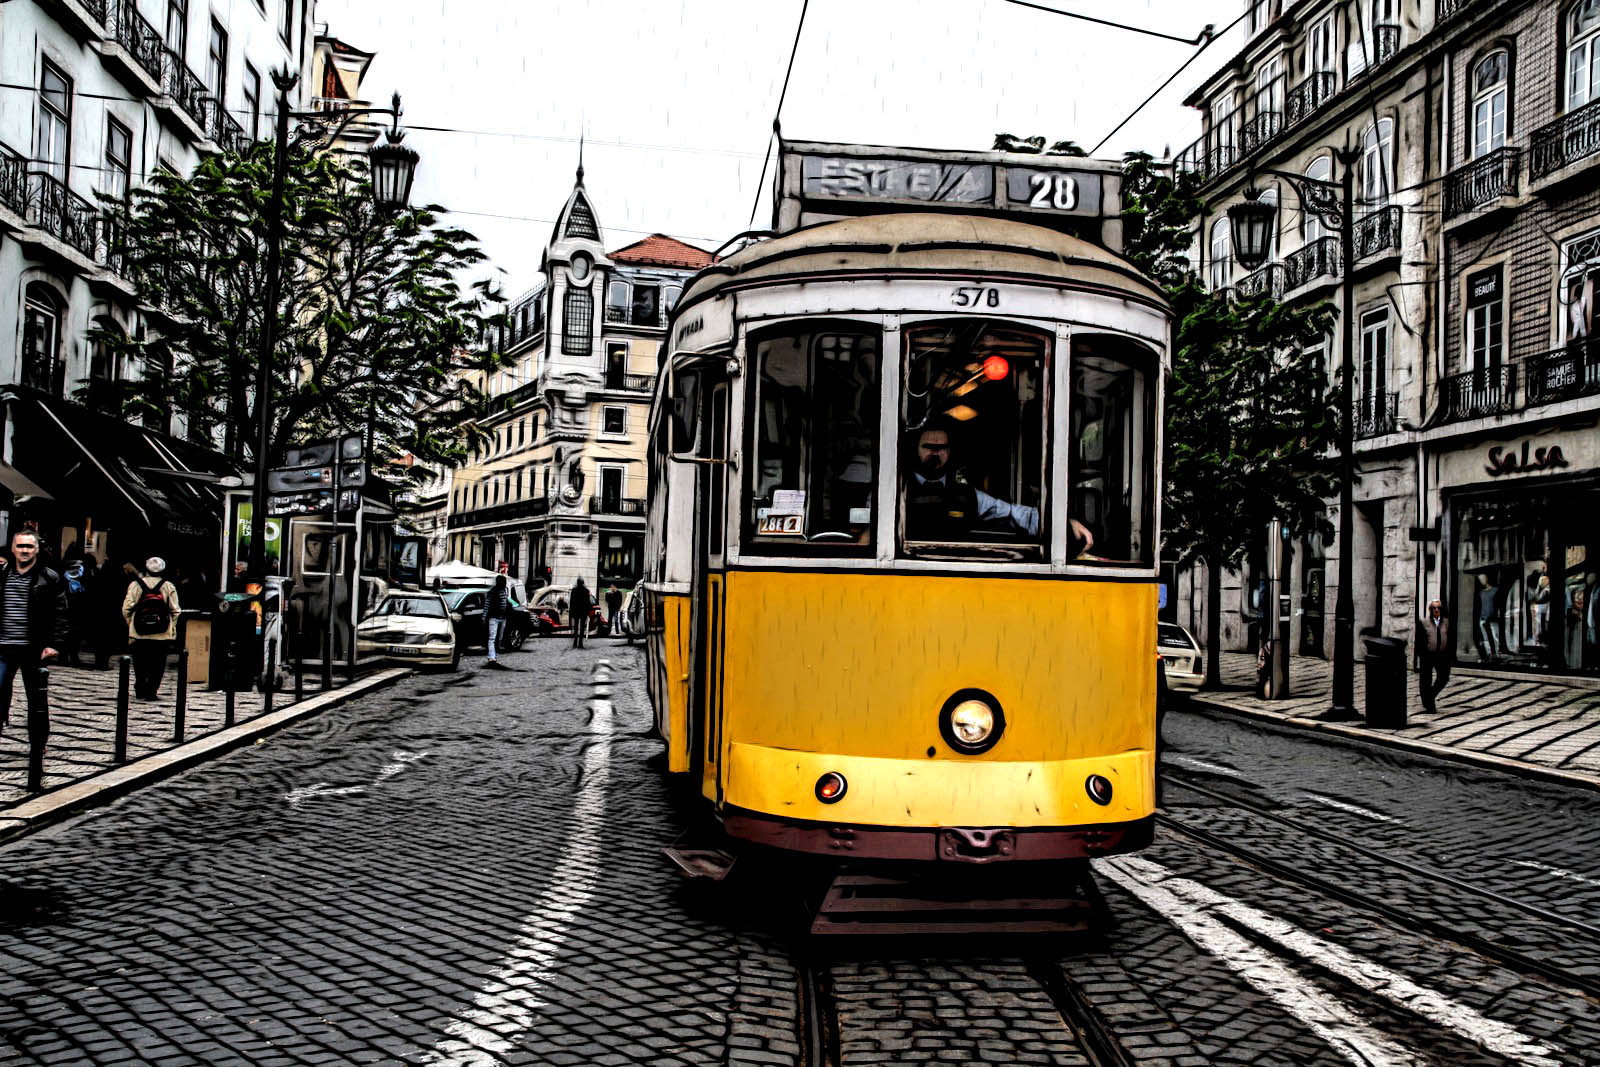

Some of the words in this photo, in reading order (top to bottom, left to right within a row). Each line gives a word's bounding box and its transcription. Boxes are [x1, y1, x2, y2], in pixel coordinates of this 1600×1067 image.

[1029, 173, 1077, 210] 28
[954, 287, 1000, 307] 578
[1547, 362, 1576, 378] SAMUEL
[1546, 374, 1577, 389] ROCHER
[1485, 440, 1568, 477] Salsa
[760, 518, 783, 531] 28E
[788, 518, 797, 530] 2
